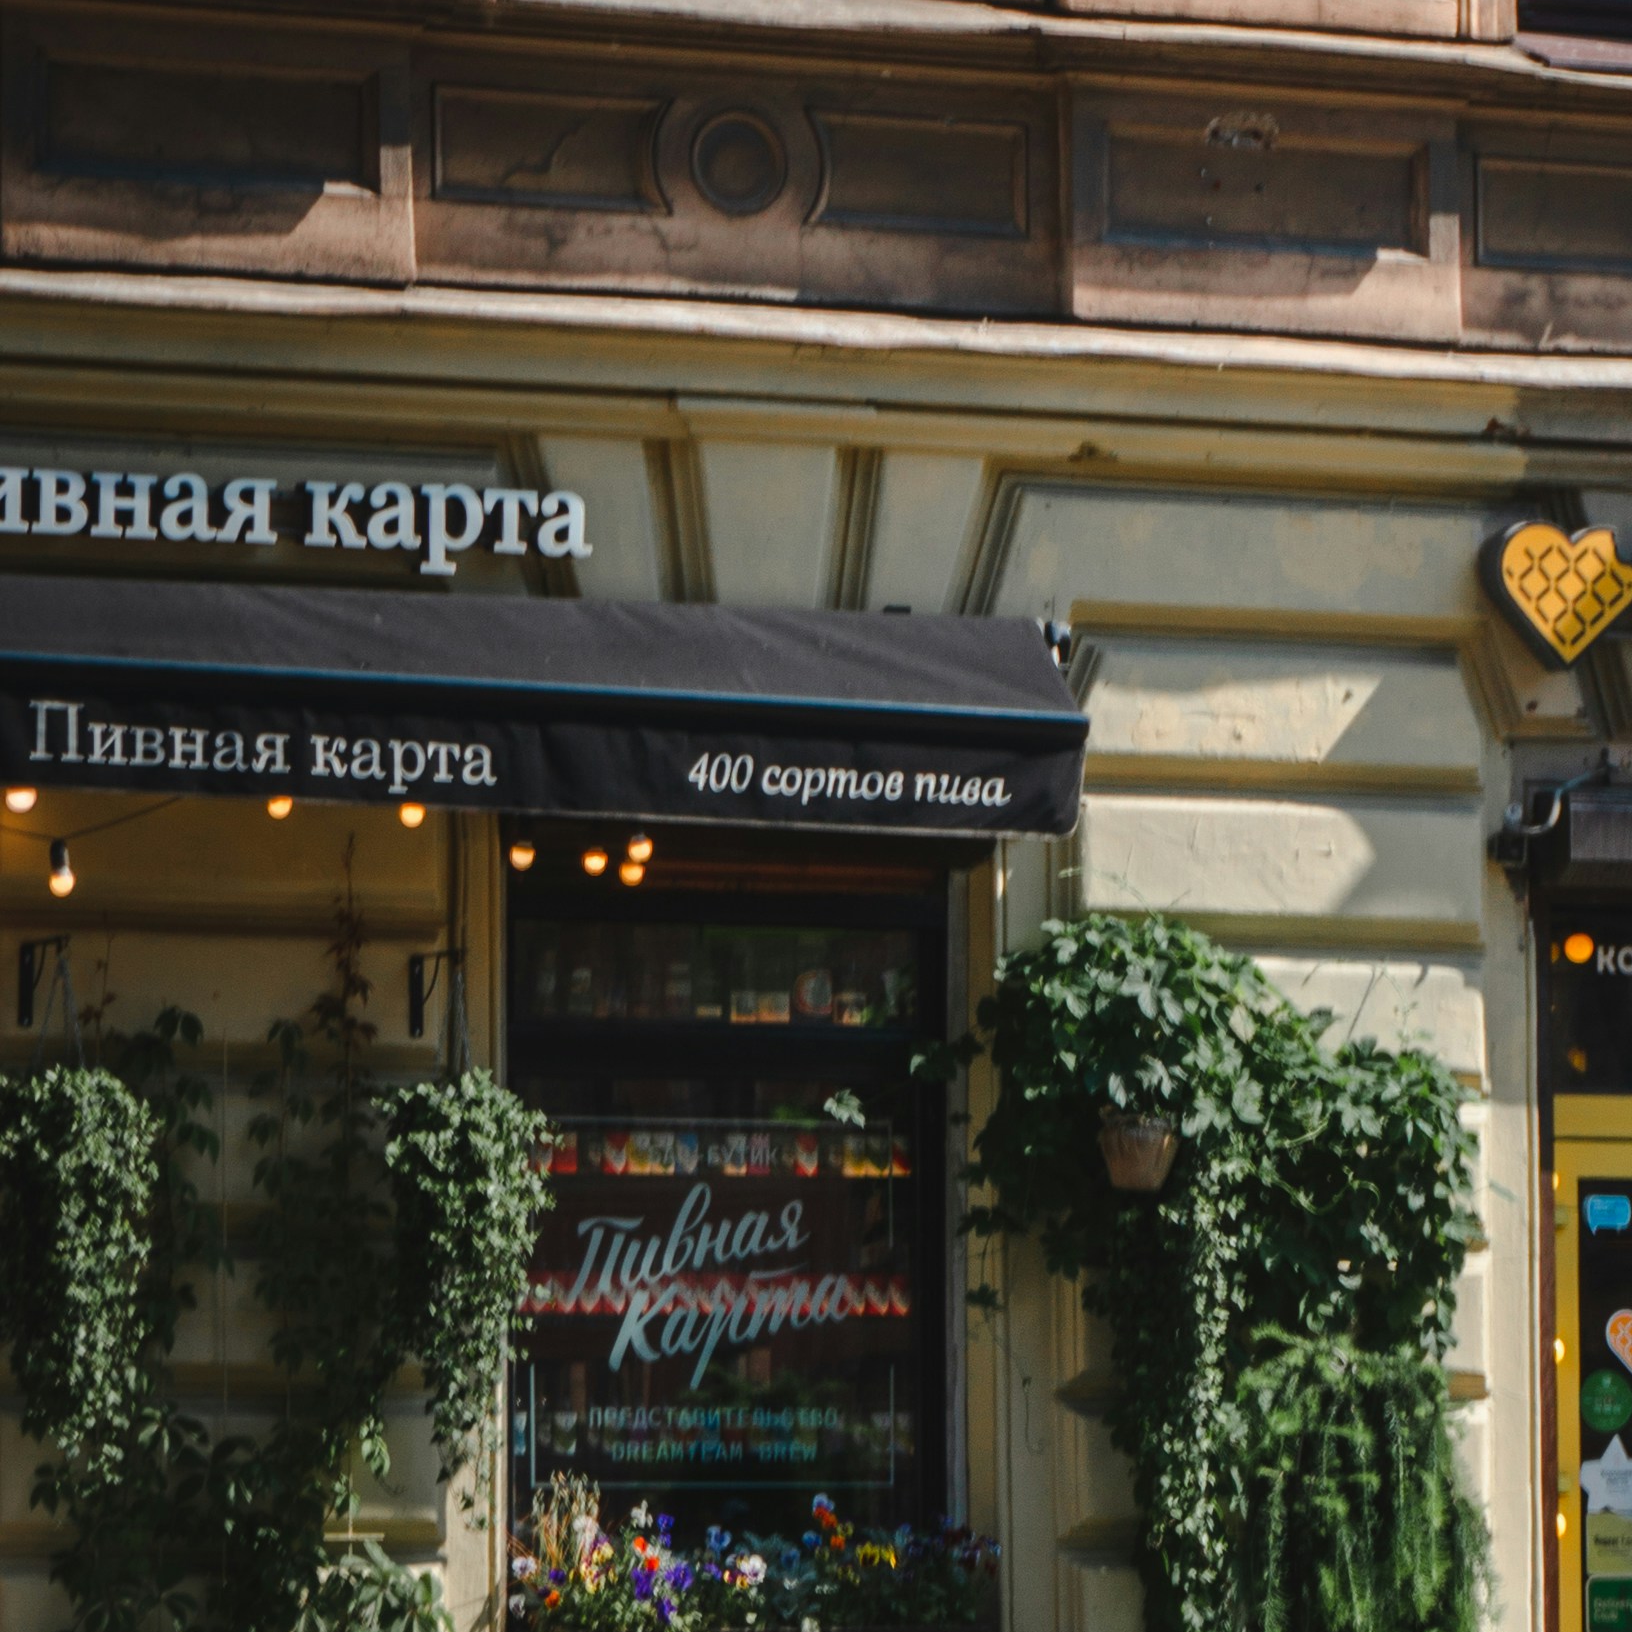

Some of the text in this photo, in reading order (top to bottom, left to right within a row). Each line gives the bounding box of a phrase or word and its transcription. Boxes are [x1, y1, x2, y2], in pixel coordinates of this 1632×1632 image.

[304, 479, 594, 577] карта
[29, 699, 498, 795] Пивная карта
[688, 753, 1013, 808] 400 сортов пива
[569, 1182, 812, 1304] Пивная
[609, 1262, 857, 1390] Карта
